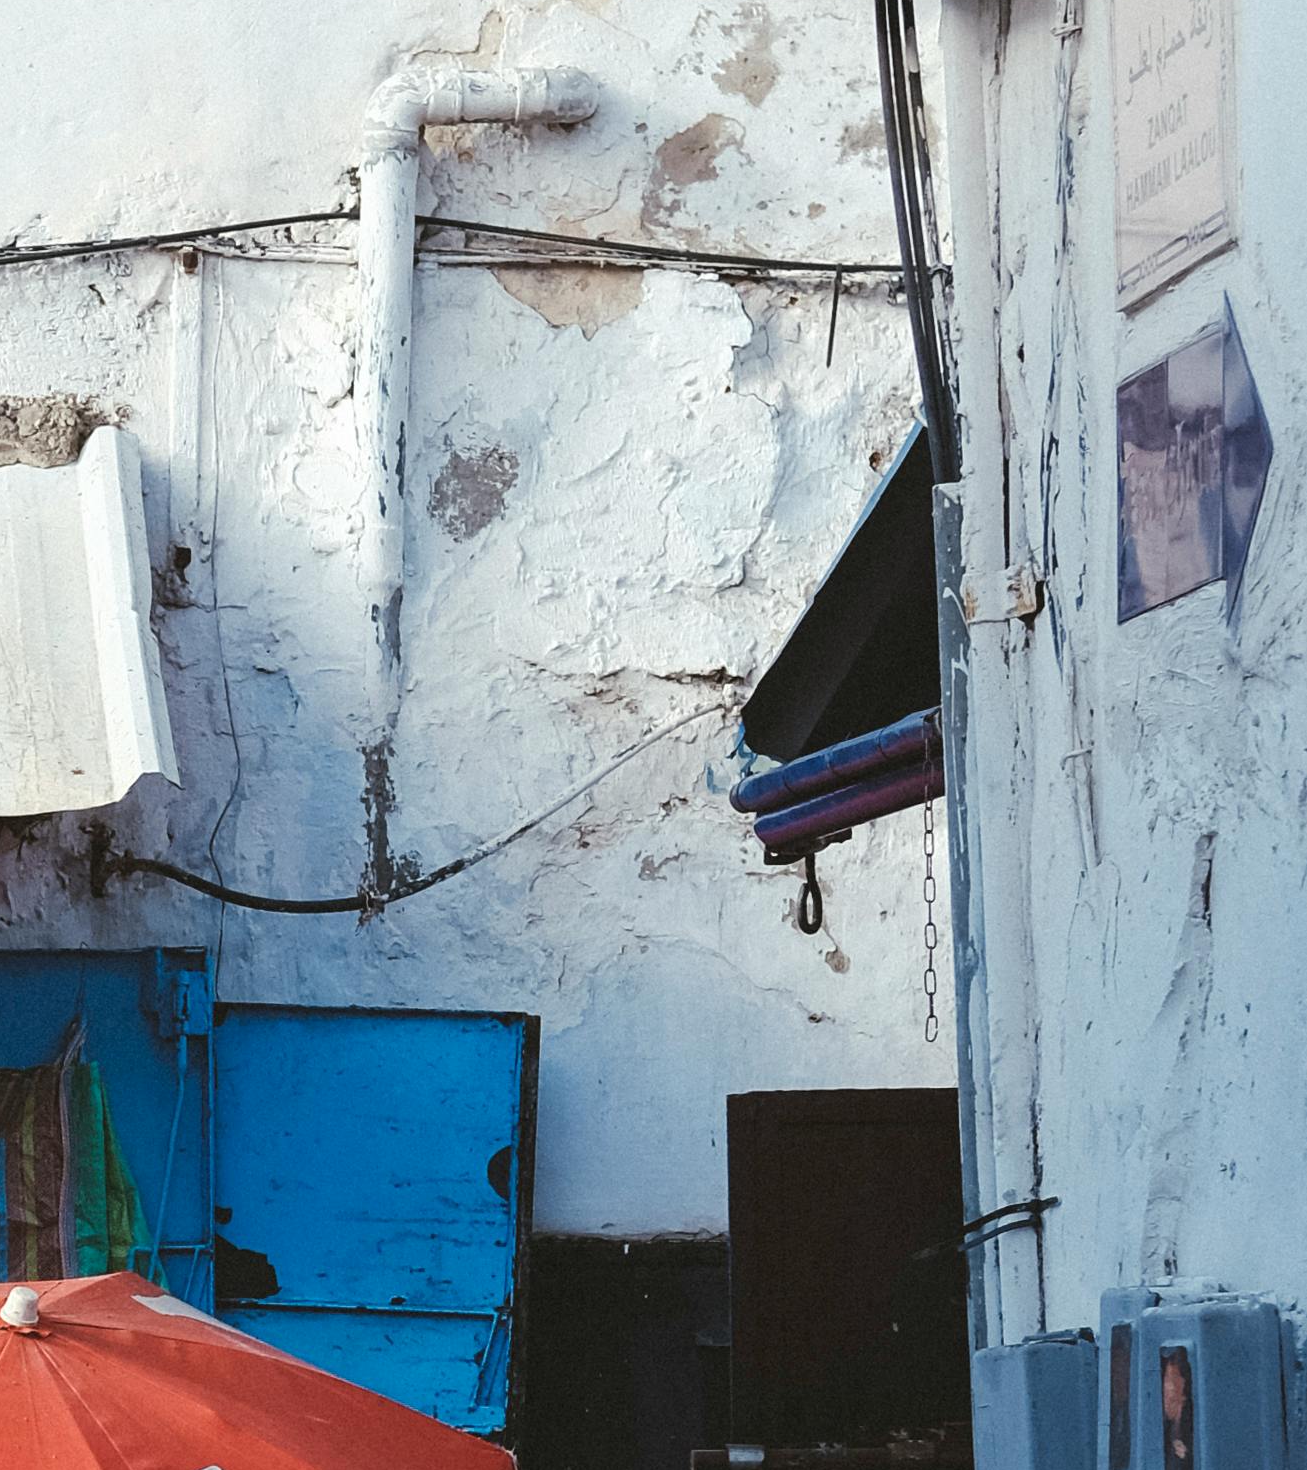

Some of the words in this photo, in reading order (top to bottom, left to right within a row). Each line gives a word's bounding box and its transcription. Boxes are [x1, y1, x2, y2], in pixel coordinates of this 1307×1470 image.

[1155, 15, 1186, 92] حمام
[1147, 93, 1188, 150] ZANQAT
[1126, 155, 1171, 213] HAMMAM
[1173, 124, 1216, 182] LAALOU
